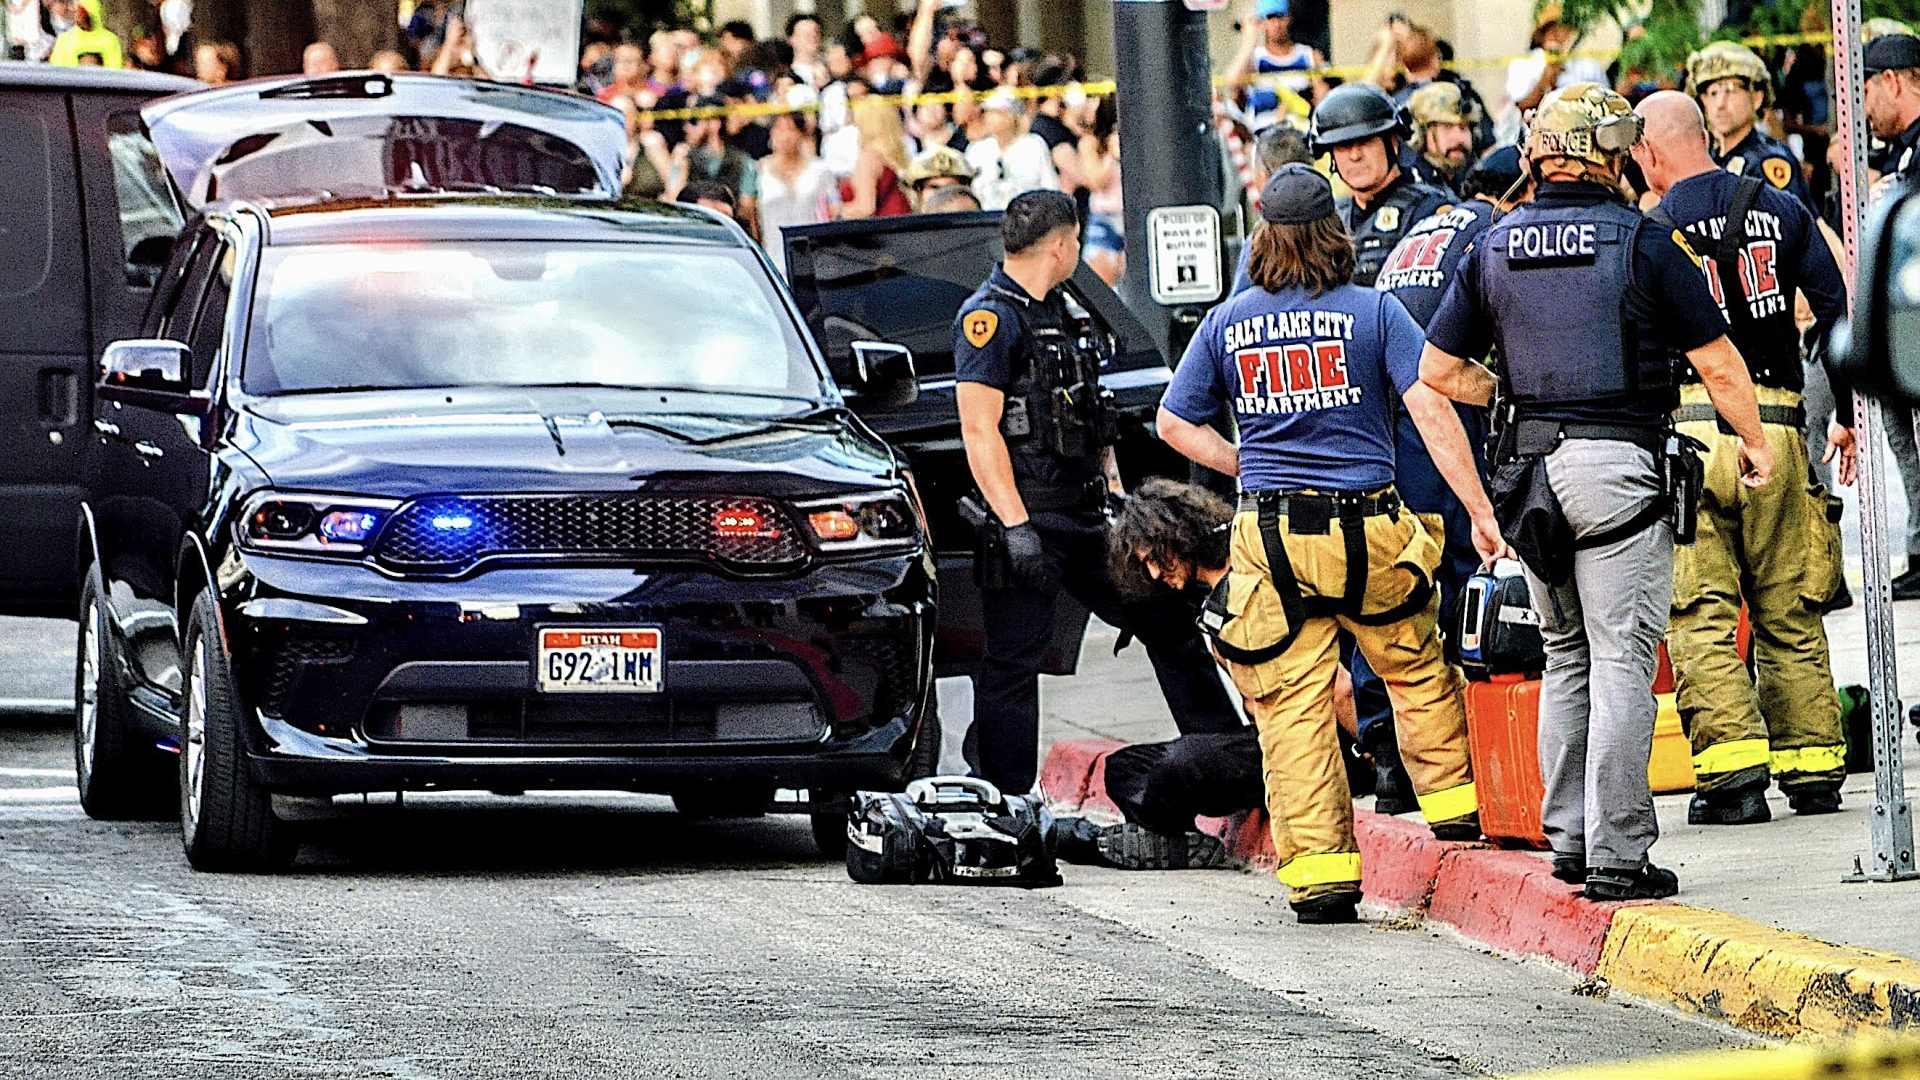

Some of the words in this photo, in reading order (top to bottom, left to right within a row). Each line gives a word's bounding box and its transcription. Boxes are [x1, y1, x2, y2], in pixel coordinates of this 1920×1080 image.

[1541, 131, 1589, 153] POLICE
[1744, 210, 1782, 240] CITY
[1508, 223, 1596, 259] POLICE
[1224, 315, 1265, 355] SALT
[1266, 310, 1312, 341] LAKE
[1313, 310, 1355, 341] CITY
[1234, 339, 1350, 399] FIRE
[1235, 386, 1363, 415] DEPARTMENT
[580, 634, 622, 646] UTAH
[549, 652, 593, 682] G92
[611, 651, 653, 682] 1WM
